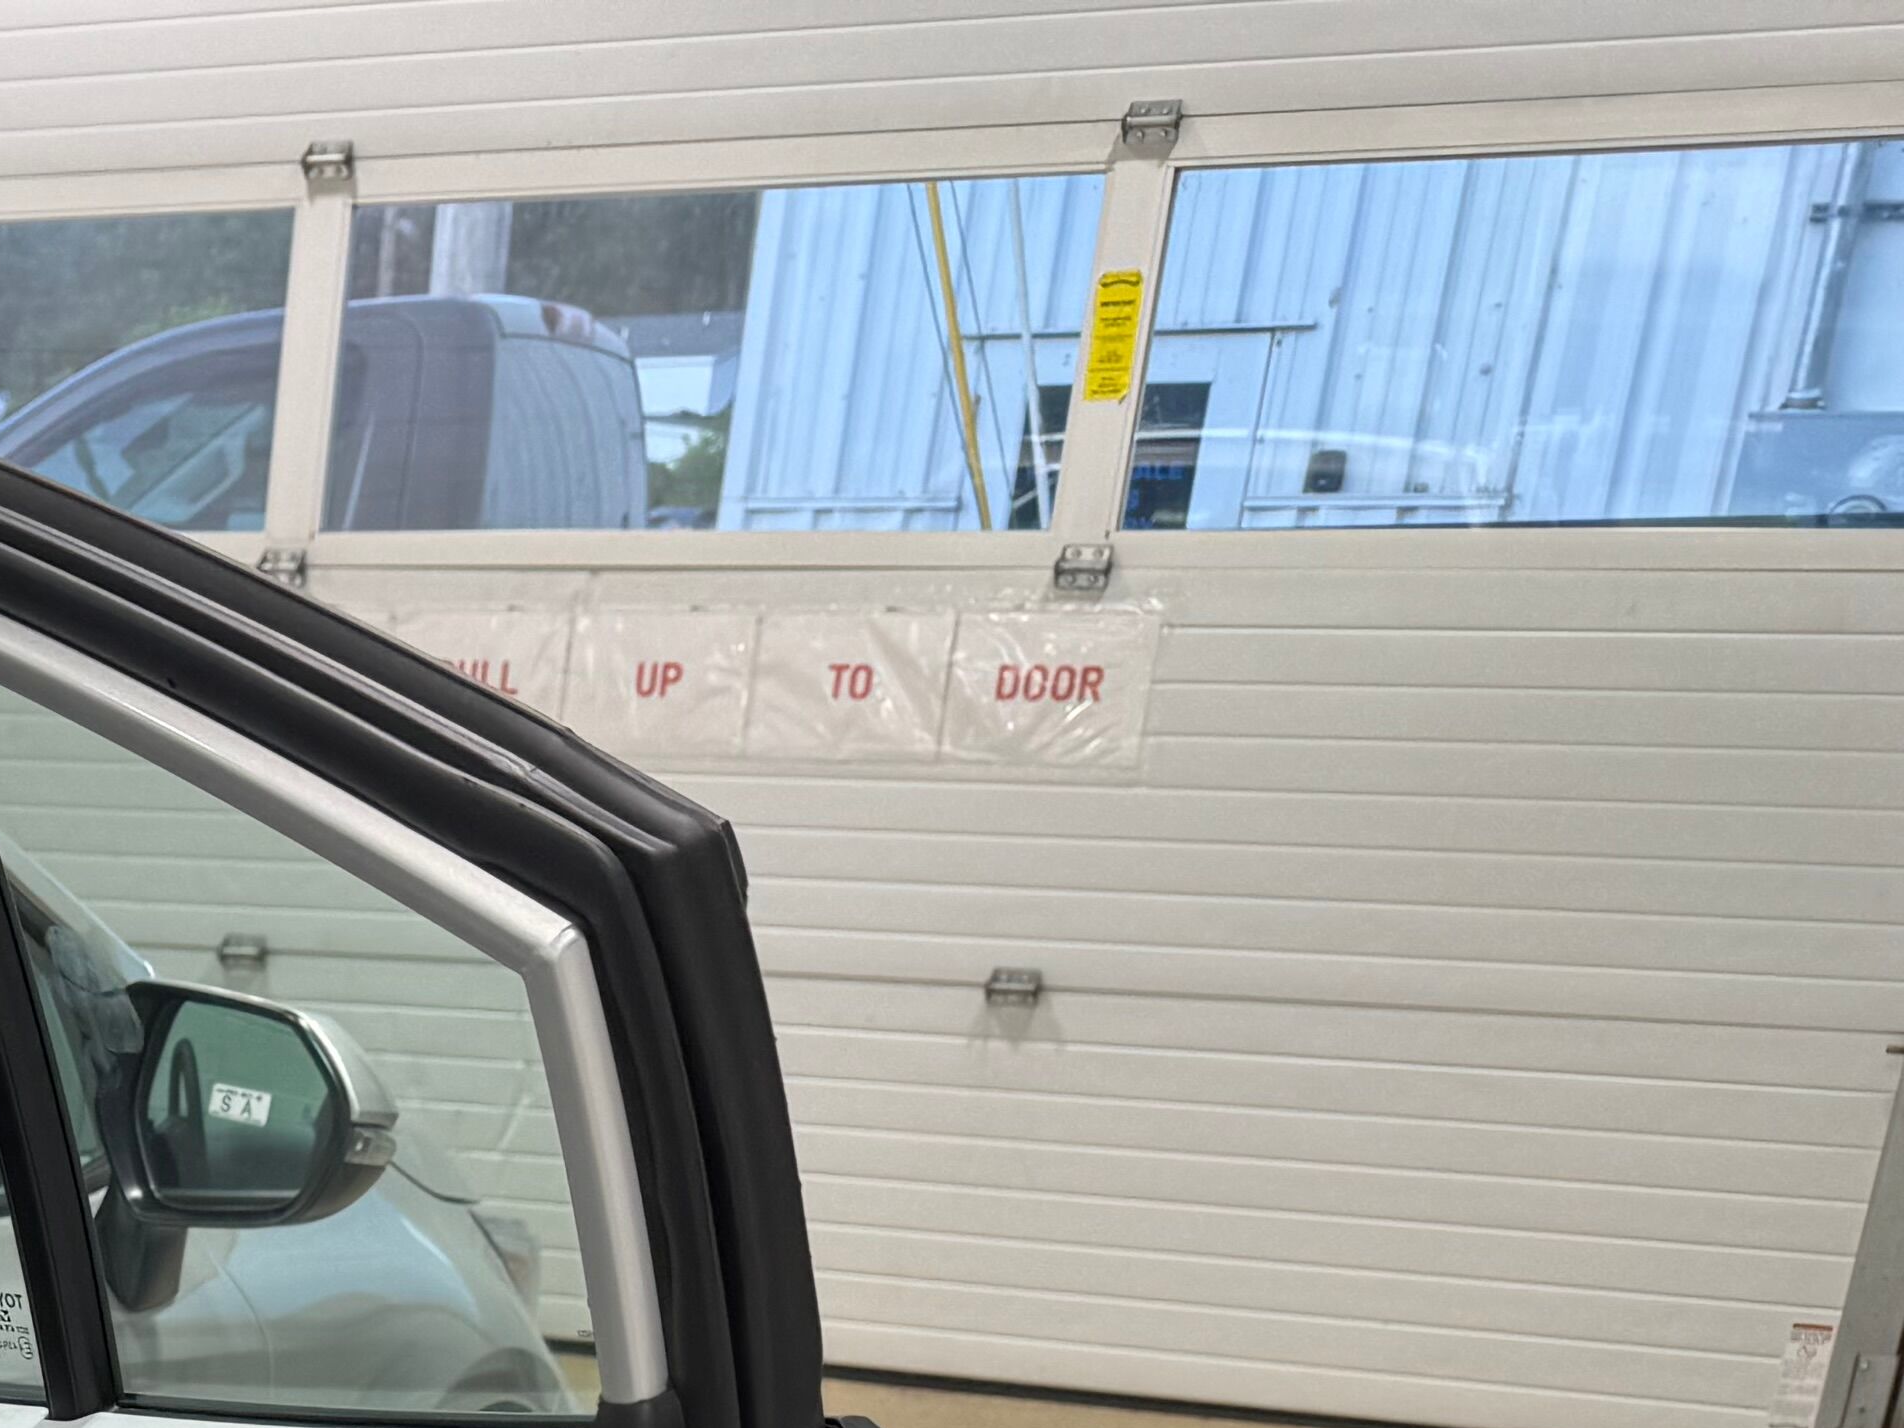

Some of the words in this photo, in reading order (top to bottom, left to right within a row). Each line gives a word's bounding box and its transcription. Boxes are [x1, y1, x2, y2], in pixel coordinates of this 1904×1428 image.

[442, 658, 519, 696] ULL
[635, 660, 684, 698] UP
[828, 662, 875, 700] TO
[994, 664, 1105, 703] DOOR
